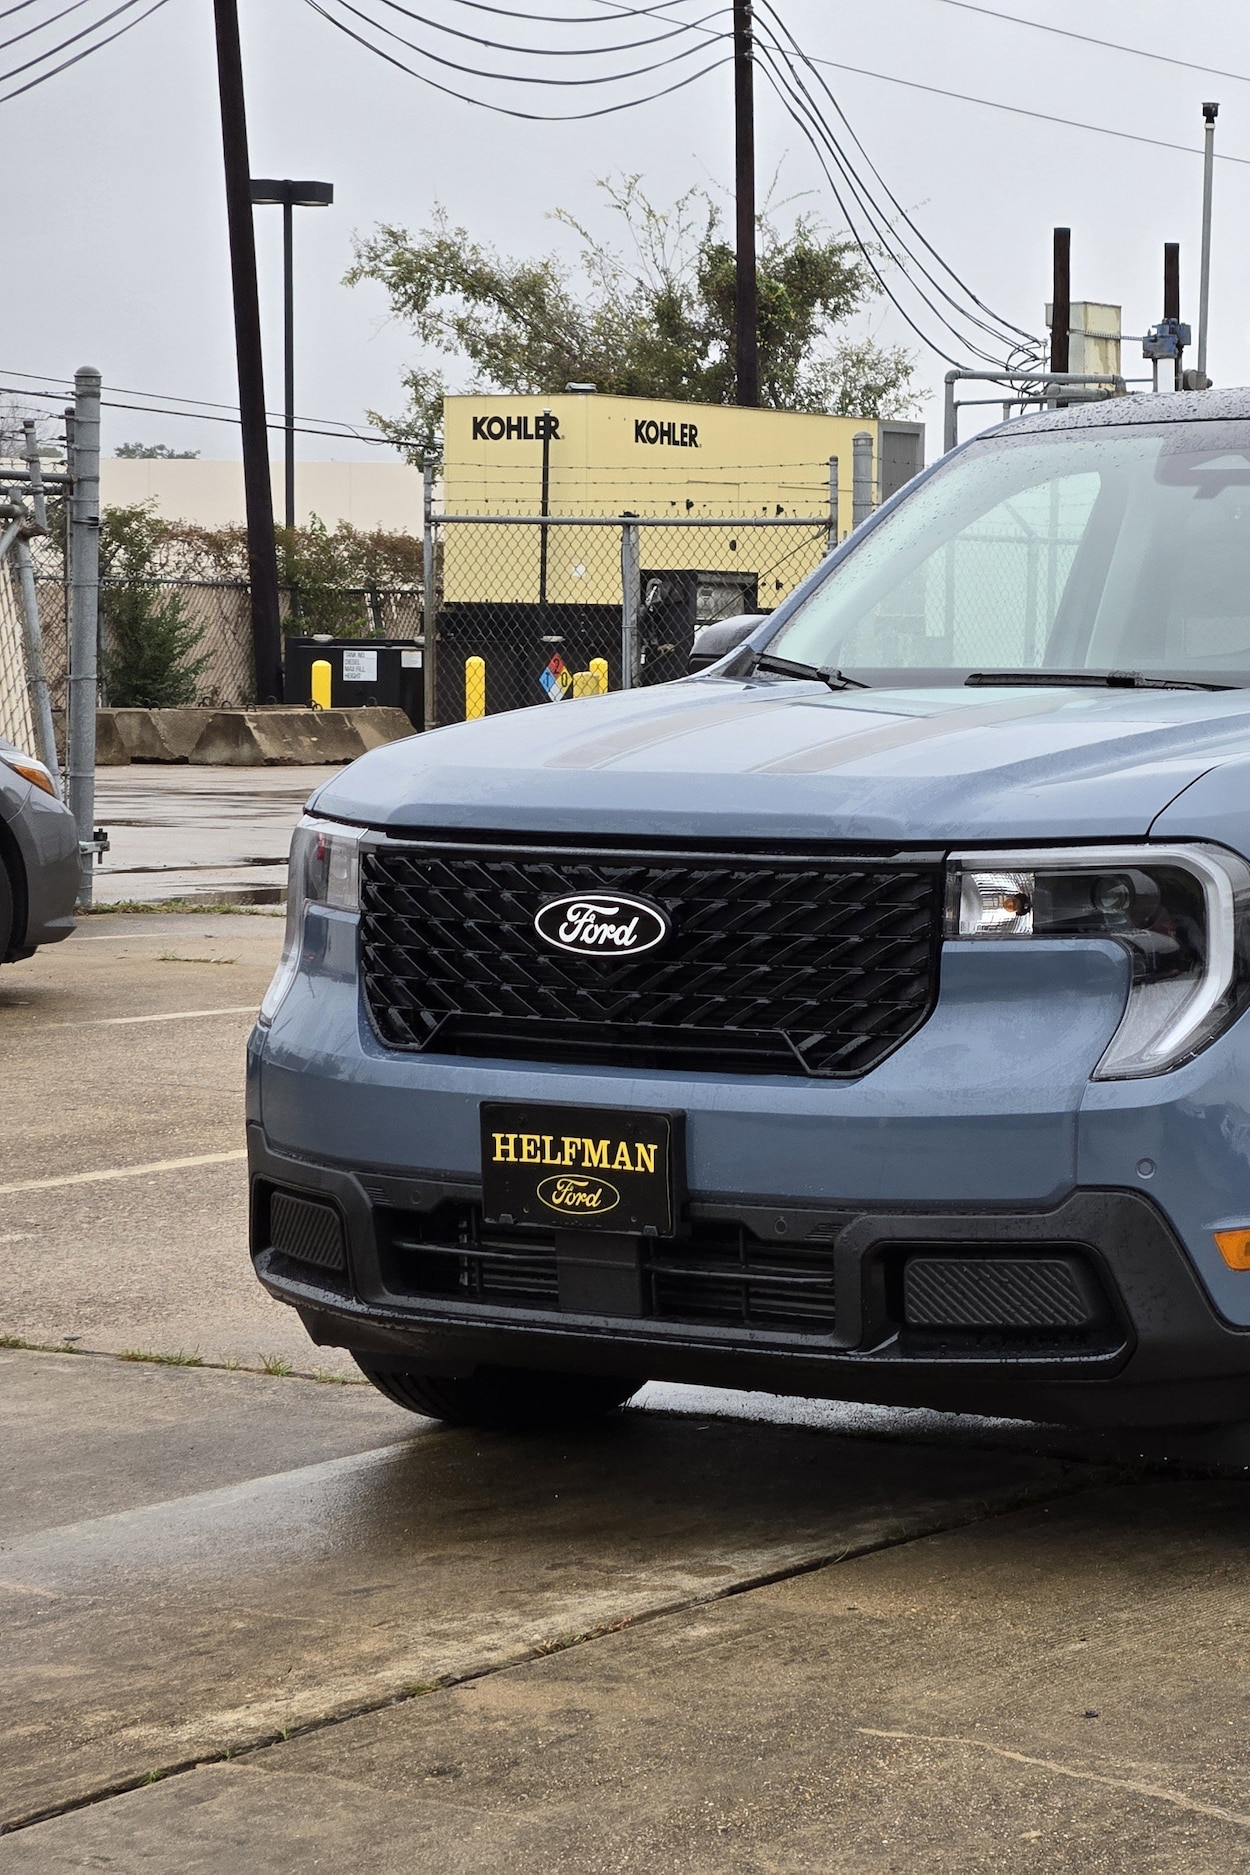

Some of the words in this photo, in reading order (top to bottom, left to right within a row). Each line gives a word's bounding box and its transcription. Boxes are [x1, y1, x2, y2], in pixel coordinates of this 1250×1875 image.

[472, 416, 561, 440] KOHLER
[634, 419, 699, 448] KOHLER
[553, 658, 560, 674] 2
[559, 903, 639, 946] Ford
[491, 1132, 658, 1173] HELFMAN
[551, 1178, 602, 1208] Ford
